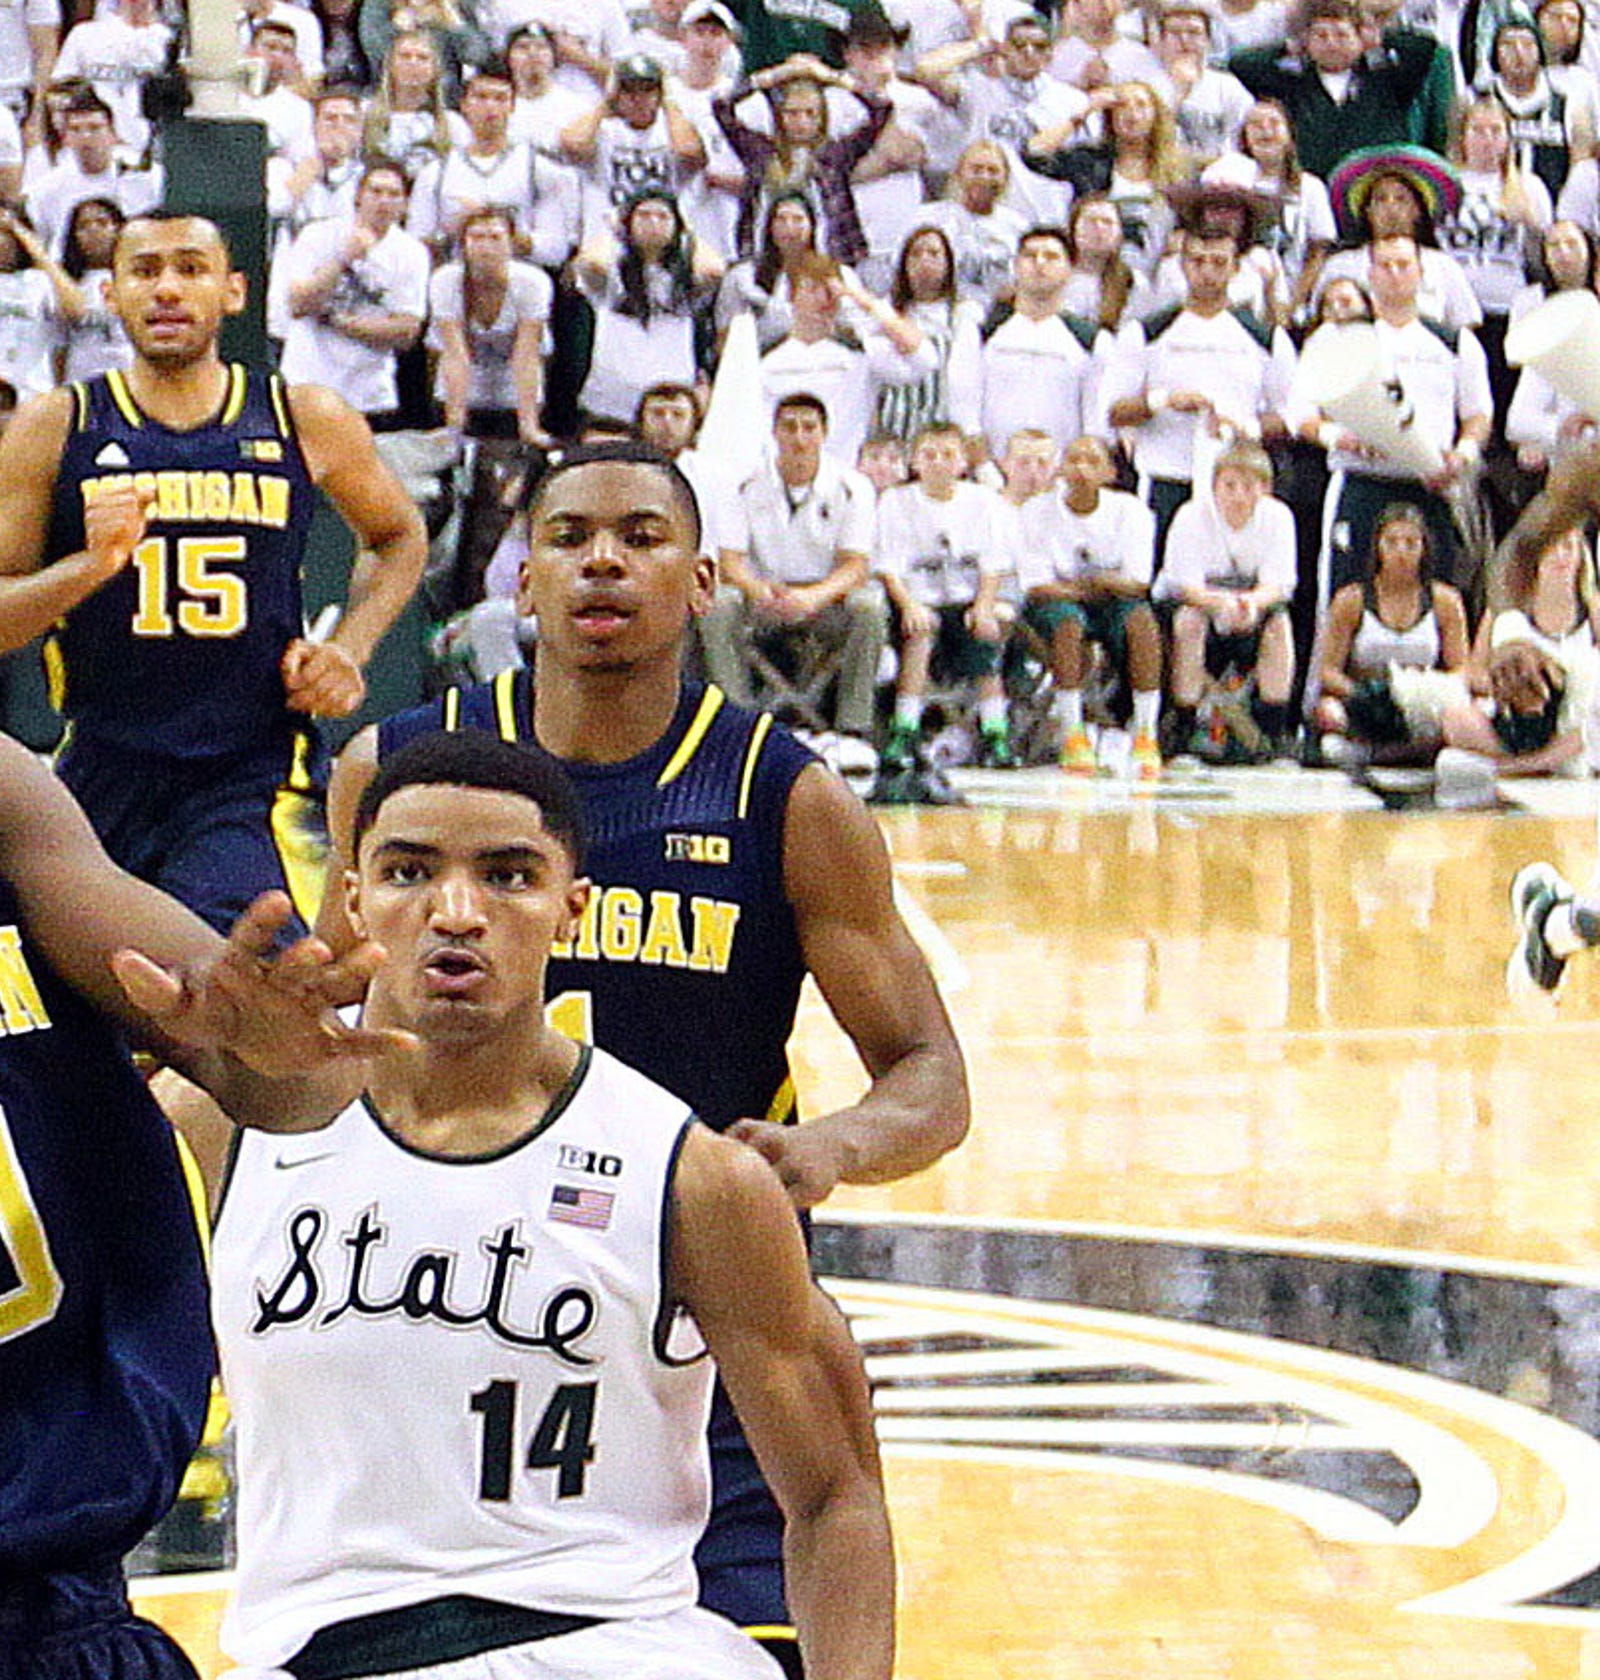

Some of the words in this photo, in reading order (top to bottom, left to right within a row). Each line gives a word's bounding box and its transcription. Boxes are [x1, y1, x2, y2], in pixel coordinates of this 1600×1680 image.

[132, 535, 247, 638] 15
[252, 1203, 605, 1374] State
[469, 1378, 599, 1502] 14
